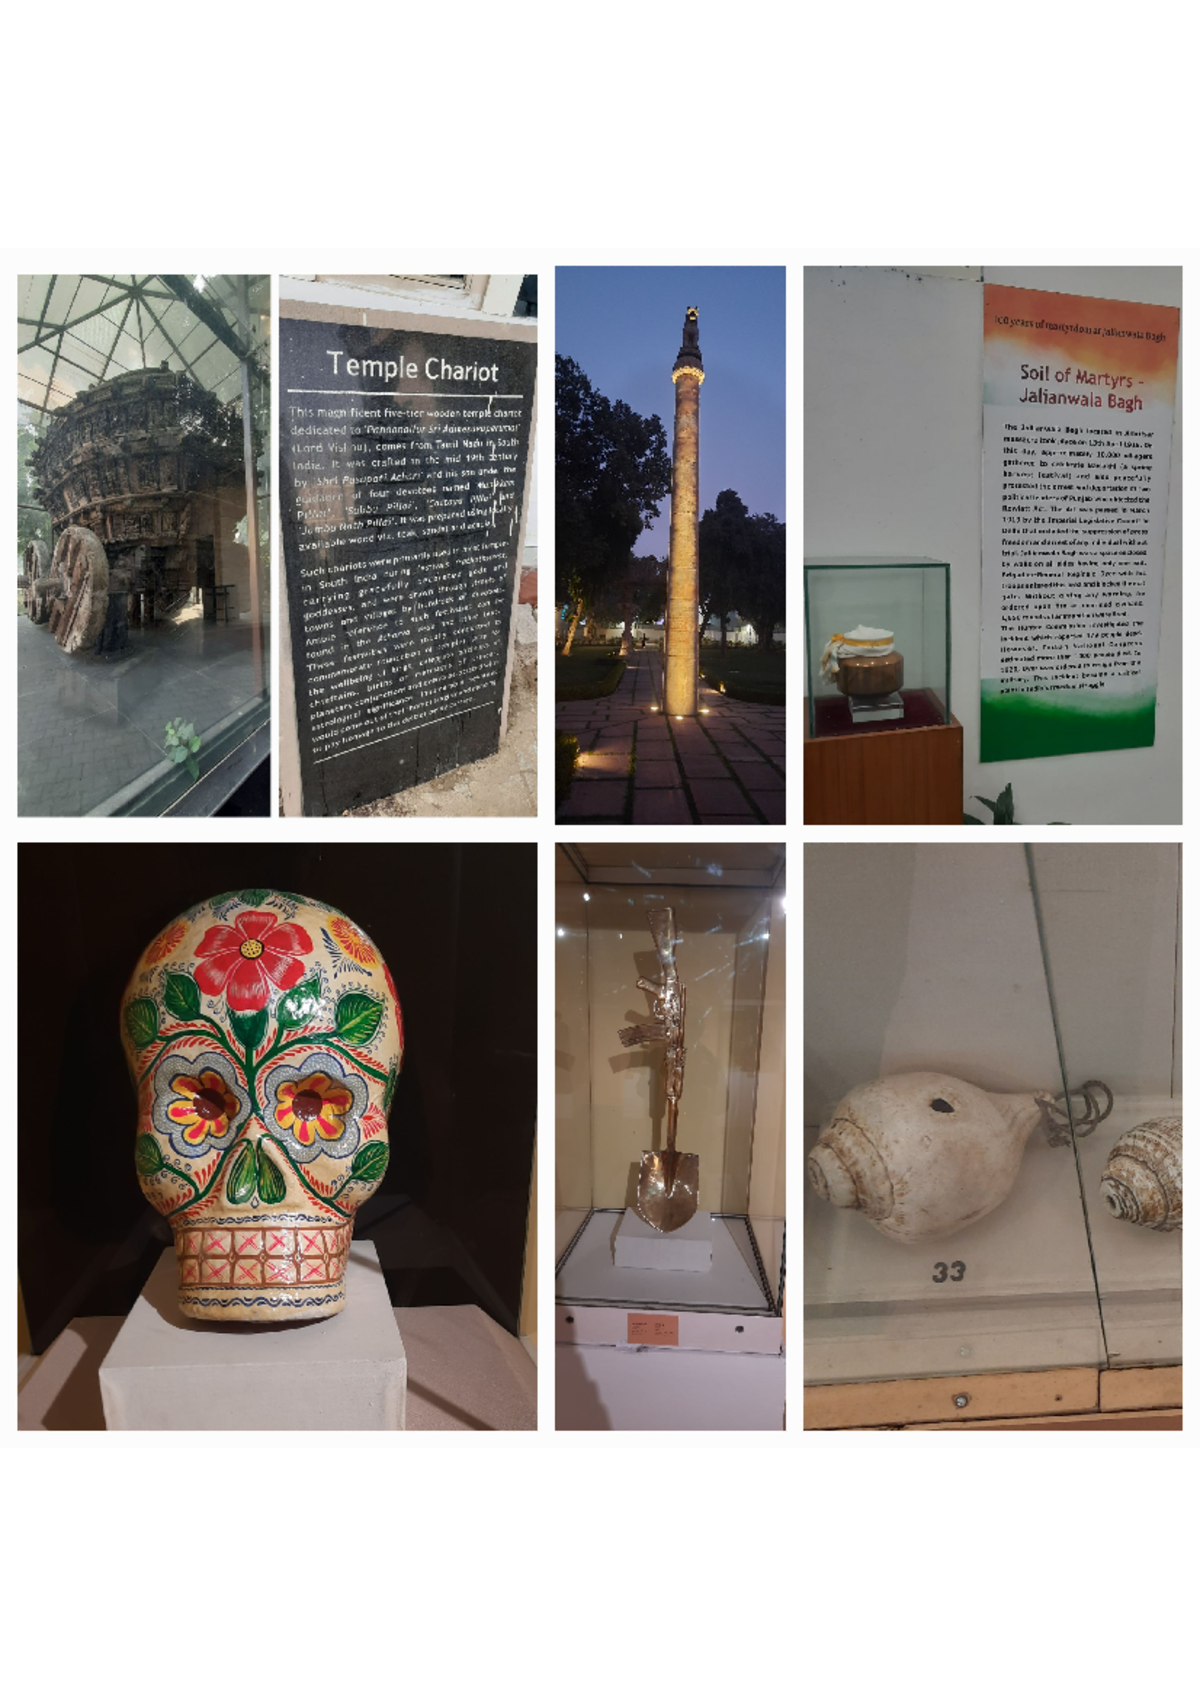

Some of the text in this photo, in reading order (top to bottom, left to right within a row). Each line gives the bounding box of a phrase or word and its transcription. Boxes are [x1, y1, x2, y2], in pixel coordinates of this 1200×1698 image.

[1010, 318, 1034, 328] years
[1035, 319, 1045, 328] of
[1045, 321, 1093, 334] martyrdom
[1146, 331, 1166, 343] Bagh
[326, 350, 499, 382] Temple Chariot
[1020, 364, 1050, 381] Soil
[1054, 367, 1072, 383] of
[1076, 369, 1133, 390] Martyrs
[1019, 387, 1143, 413] Jalianwala Bagh
[289, 405, 522, 419] This magnficent five-tier wooden temple chariot
[290, 425, 347, 436] dedicated
[350, 426, 361, 435] to
[292, 442, 323, 454] (Lord
[375, 442, 406, 452] comes
[410, 441, 432, 450] from
[435, 439, 459, 449] Tamil
[463, 438, 483, 447] Nadu
[486, 439, 493, 447] in
[497, 438, 519, 447] South
[293, 460, 325, 471] India.
[332, 459, 340, 469] It
[346, 460, 365, 468] was
[371, 457, 406, 468] crafted
[411, 457, 420, 465] in
[425, 456, 439, 465] the
[445, 454, 461, 463] mid
[294, 477, 307, 489] by
[351, 490, 361, 500] of
[369, 489, 390, 498] four
[300, 566, 325, 578] Such
[327, 561, 367, 573] chariots
[368, 557, 392, 567] were
[318, 577, 348, 590] South
[303, 592, 350, 606] carrying
[304, 621, 334, 633] towns
[309, 687, 325, 697] the
[932, 1260, 967, 1283] 33
